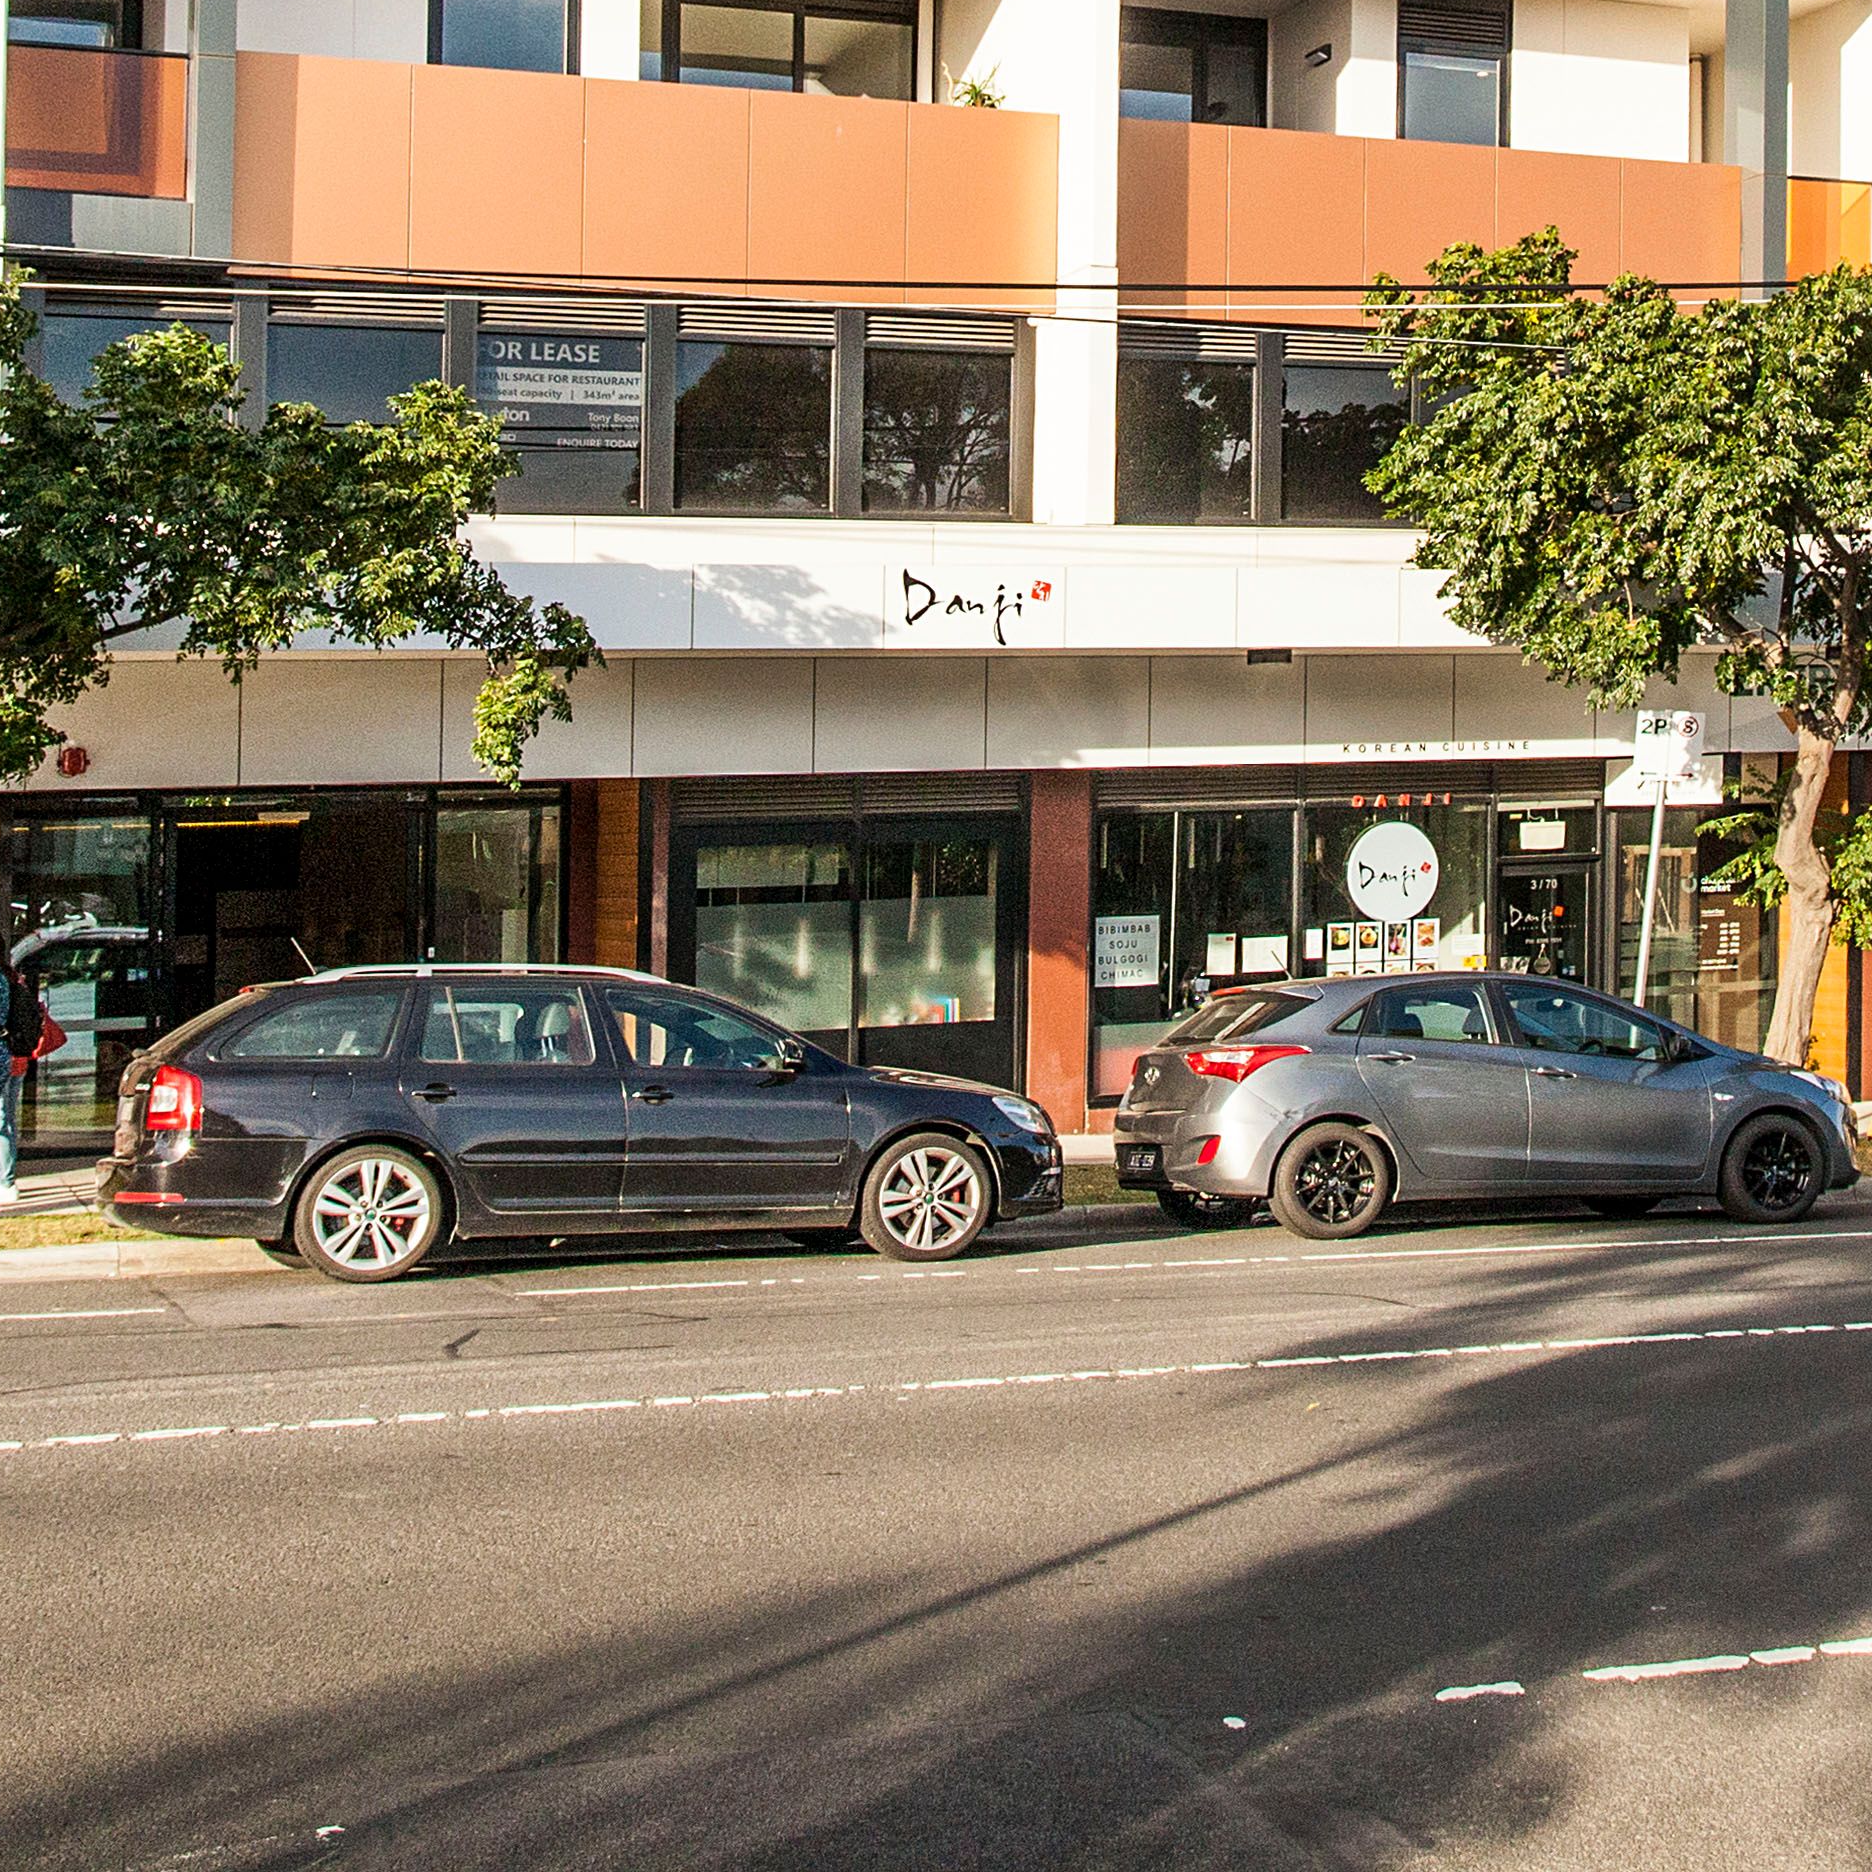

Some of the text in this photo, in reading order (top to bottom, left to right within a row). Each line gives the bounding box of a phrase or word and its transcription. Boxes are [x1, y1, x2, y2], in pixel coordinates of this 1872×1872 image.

[489, 340, 600, 363] OR LEASE
[513, 372, 544, 383] SPACE
[548, 374, 568, 383] FOR
[571, 375, 639, 386] RESTAURANT
[520, 390, 562, 400] capacity
[618, 393, 639, 401] area
[588, 412, 611, 423] Tony
[556, 438, 639, 448] ENQUIRE TODAY
[903, 568, 1022, 646] Danji
[1641, 718, 1667, 734] 2P
[1343, 741, 1529, 753] KOREAN CUISINE
[1352, 792, 1451, 808] DANJI
[1358, 861, 1416, 896] Danji
[1509, 904, 1553, 934] Danji
[1109, 940, 1137, 949] SOJU
[1098, 954, 1148, 965] BULGOGI
[1101, 969, 1144, 980] CHIMAC
